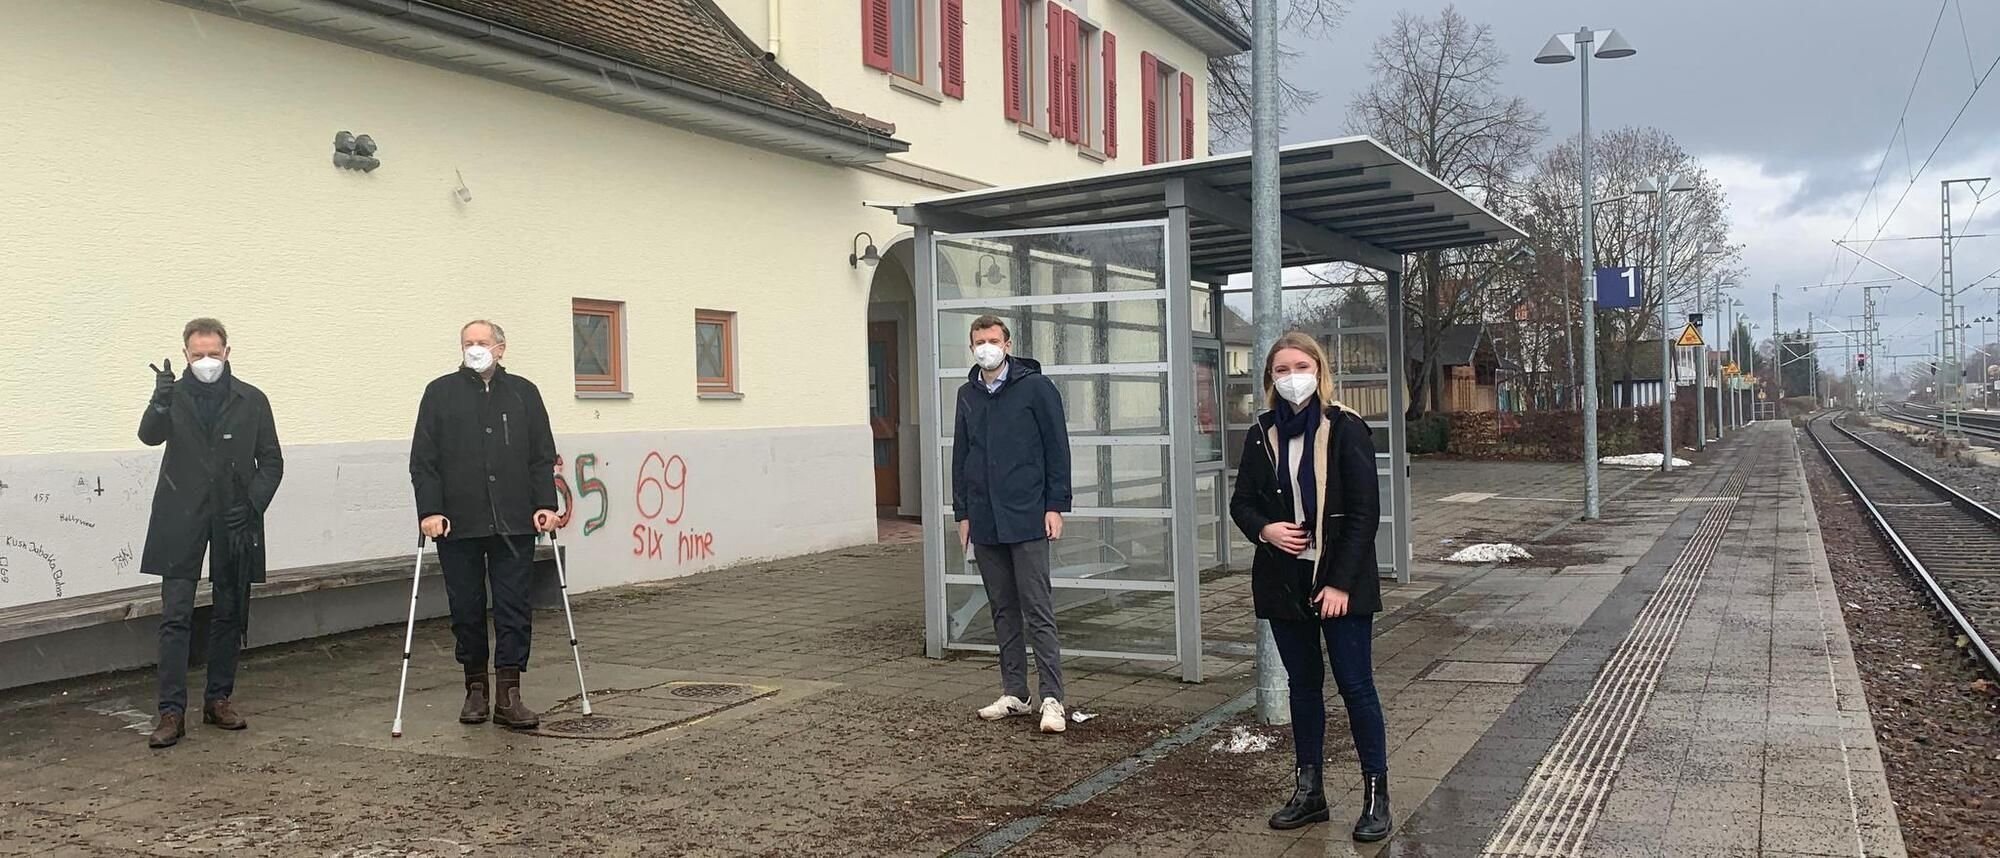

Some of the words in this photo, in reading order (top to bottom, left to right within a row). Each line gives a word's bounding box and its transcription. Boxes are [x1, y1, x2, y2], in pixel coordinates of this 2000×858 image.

[1621, 267, 1635, 297] 1
[636, 451, 687, 525] 69
[678, 527, 716, 565] nine
